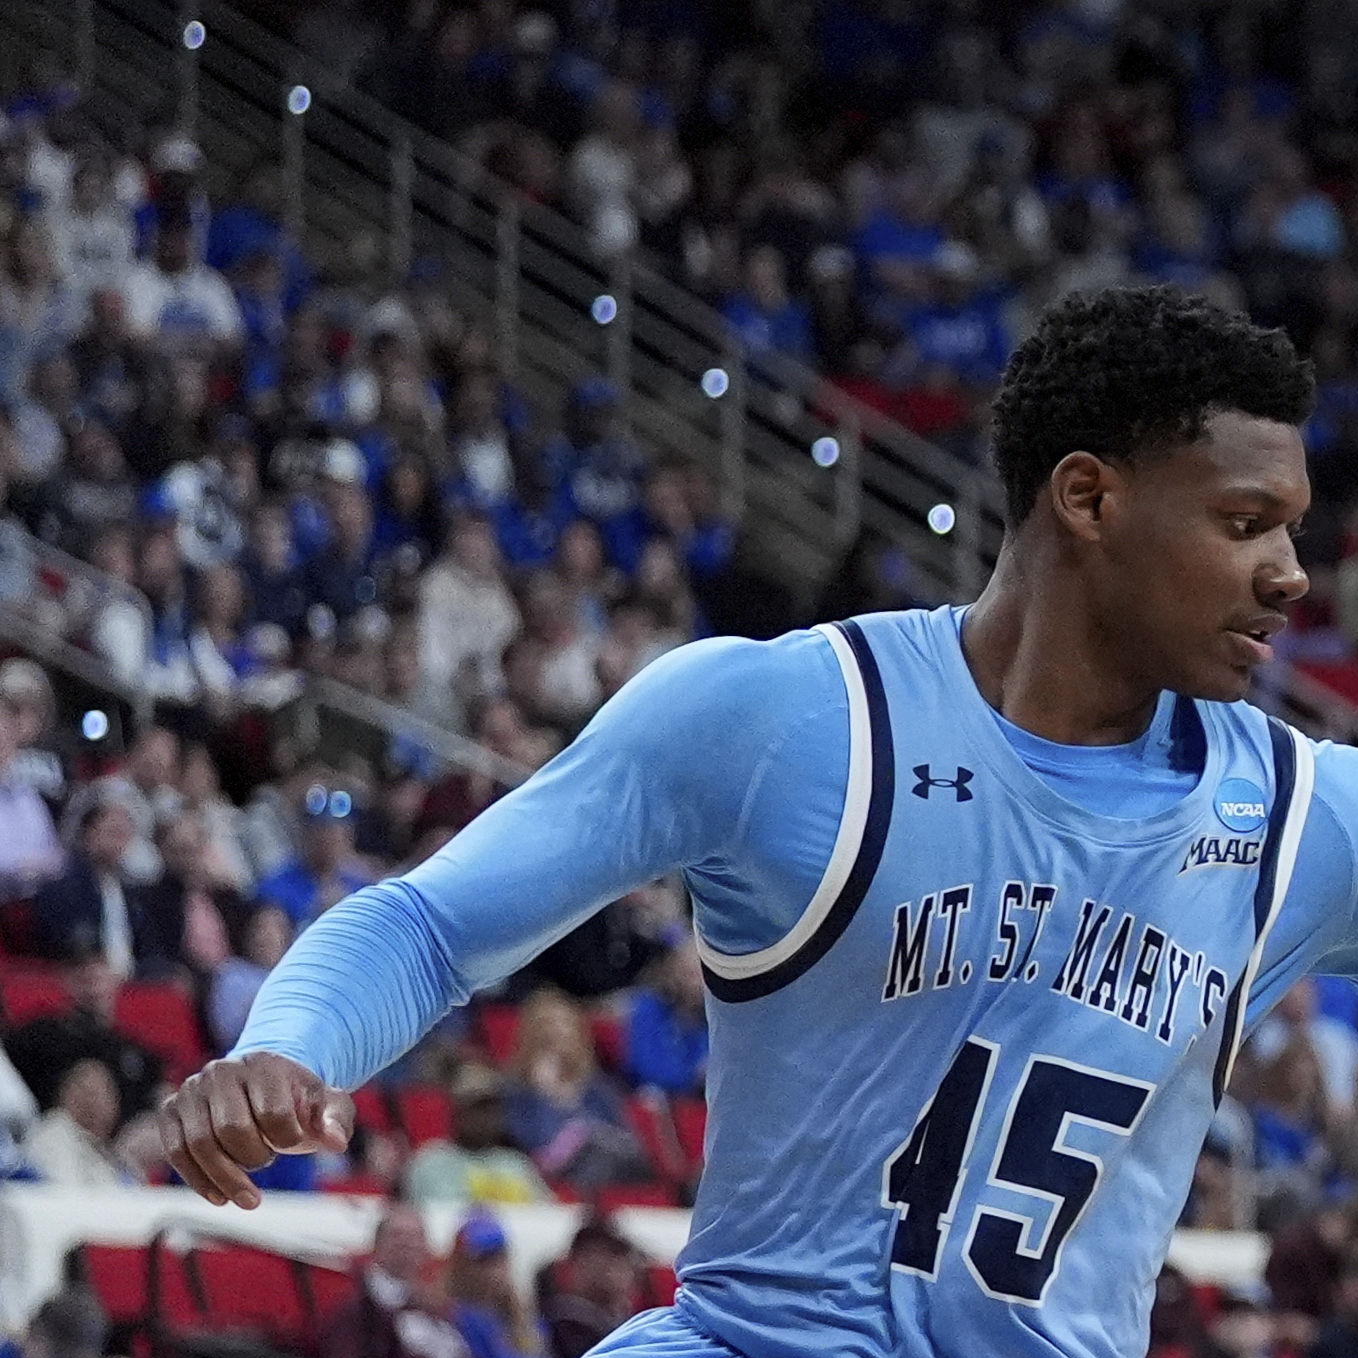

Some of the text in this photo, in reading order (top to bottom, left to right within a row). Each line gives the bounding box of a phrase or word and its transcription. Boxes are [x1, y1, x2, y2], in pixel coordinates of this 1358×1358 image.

[1221, 802, 1266, 818] NCAA
[1178, 836, 1260, 874] MAAC
[881, 883, 974, 1003] MT.
[987, 880, 1059, 984] ST.
[881, 1034, 1157, 1308] 45
